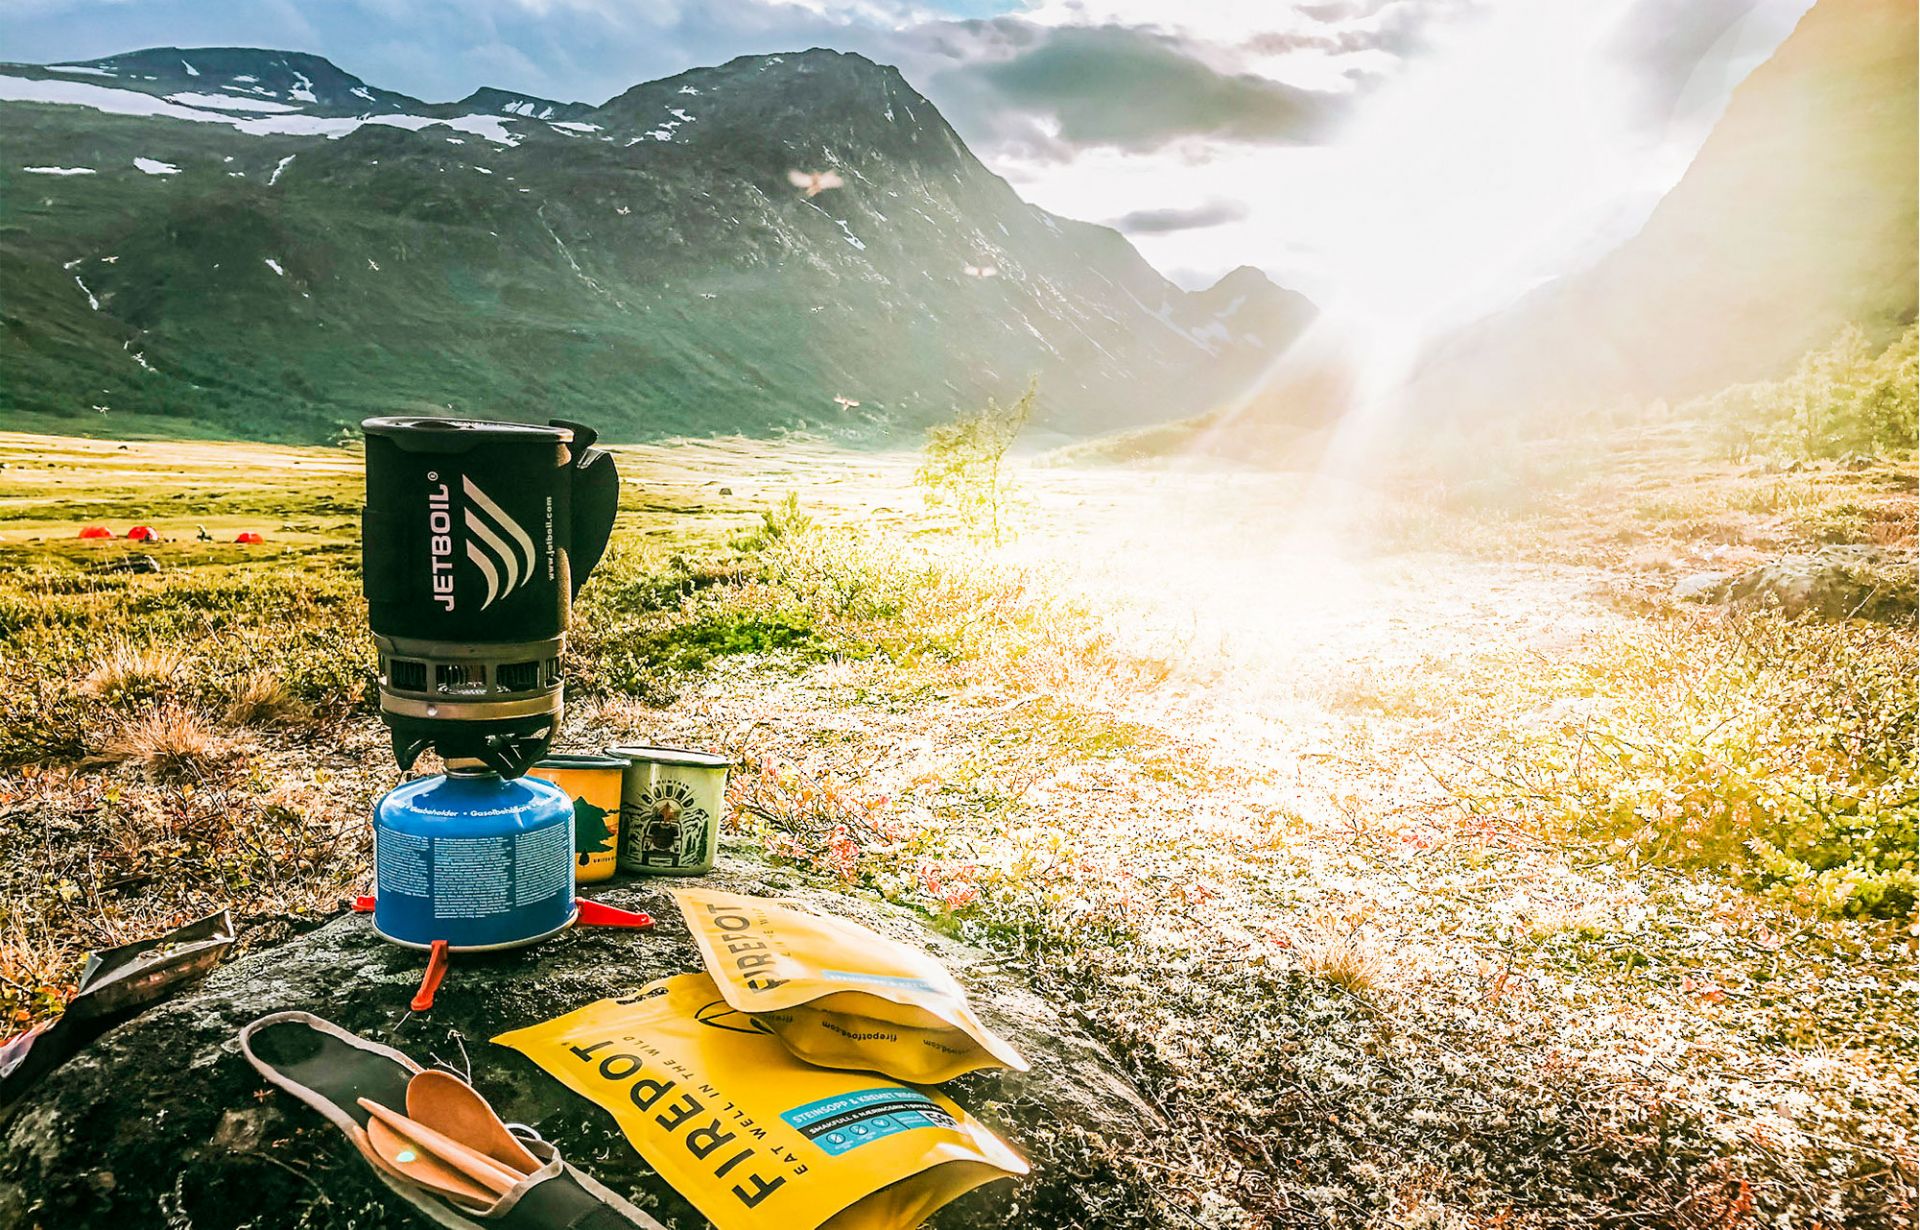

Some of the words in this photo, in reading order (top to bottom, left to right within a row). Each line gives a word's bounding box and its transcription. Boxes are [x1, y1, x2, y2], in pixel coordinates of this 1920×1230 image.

[706, 903, 791, 994] FIREPOT
[622, 1036, 660, 1057] WILD
[663, 1059, 694, 1080] THE
[698, 1084, 720, 1098] IN
[723, 1101, 767, 1140] WELL
[792, 1100, 849, 1124] STEINSOPP
[848, 1097, 859, 1105] &
[808, 1115, 853, 1135] SMAKFULL
[770, 1145, 809, 1176] EAT
